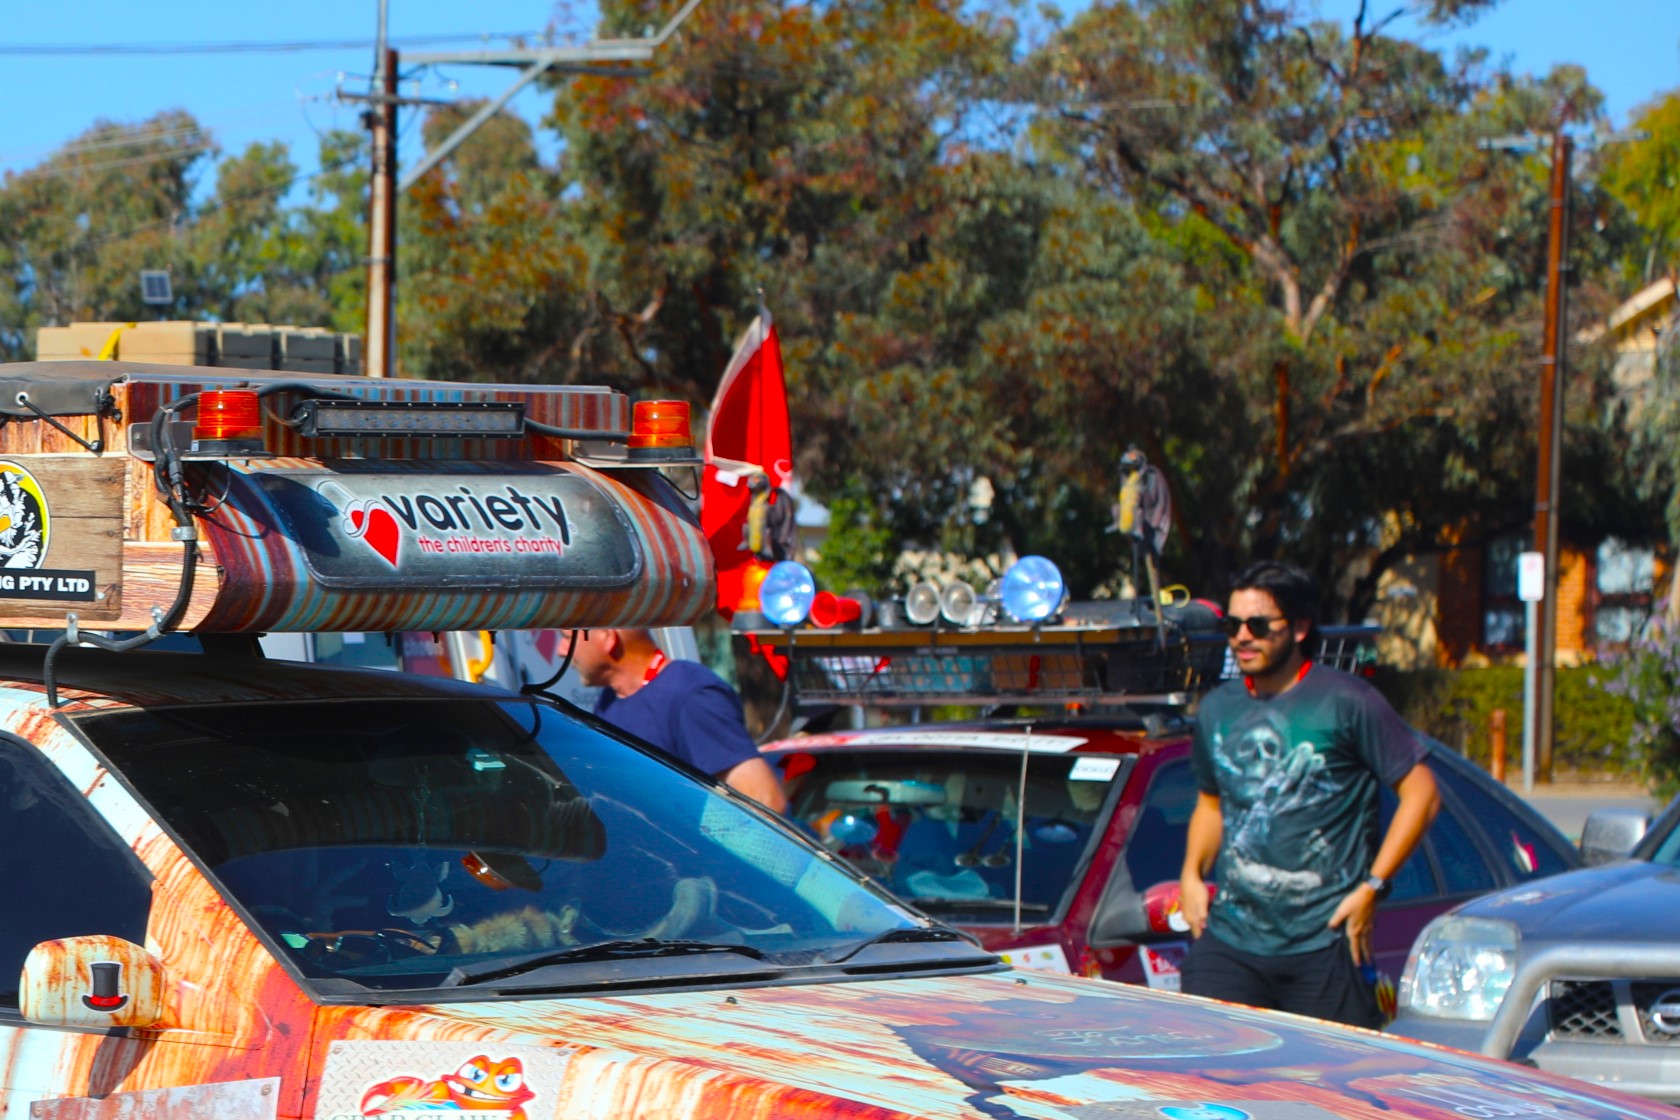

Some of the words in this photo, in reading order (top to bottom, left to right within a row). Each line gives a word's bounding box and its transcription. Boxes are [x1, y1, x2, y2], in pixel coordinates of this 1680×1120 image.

[381, 486, 570, 546] variety
[418, 536, 444, 553] the
[447, 536, 511, 554] children's
[515, 536, 563, 556] charity
[18, 574, 53, 592] PTY
[56, 575, 90, 594] LTD
